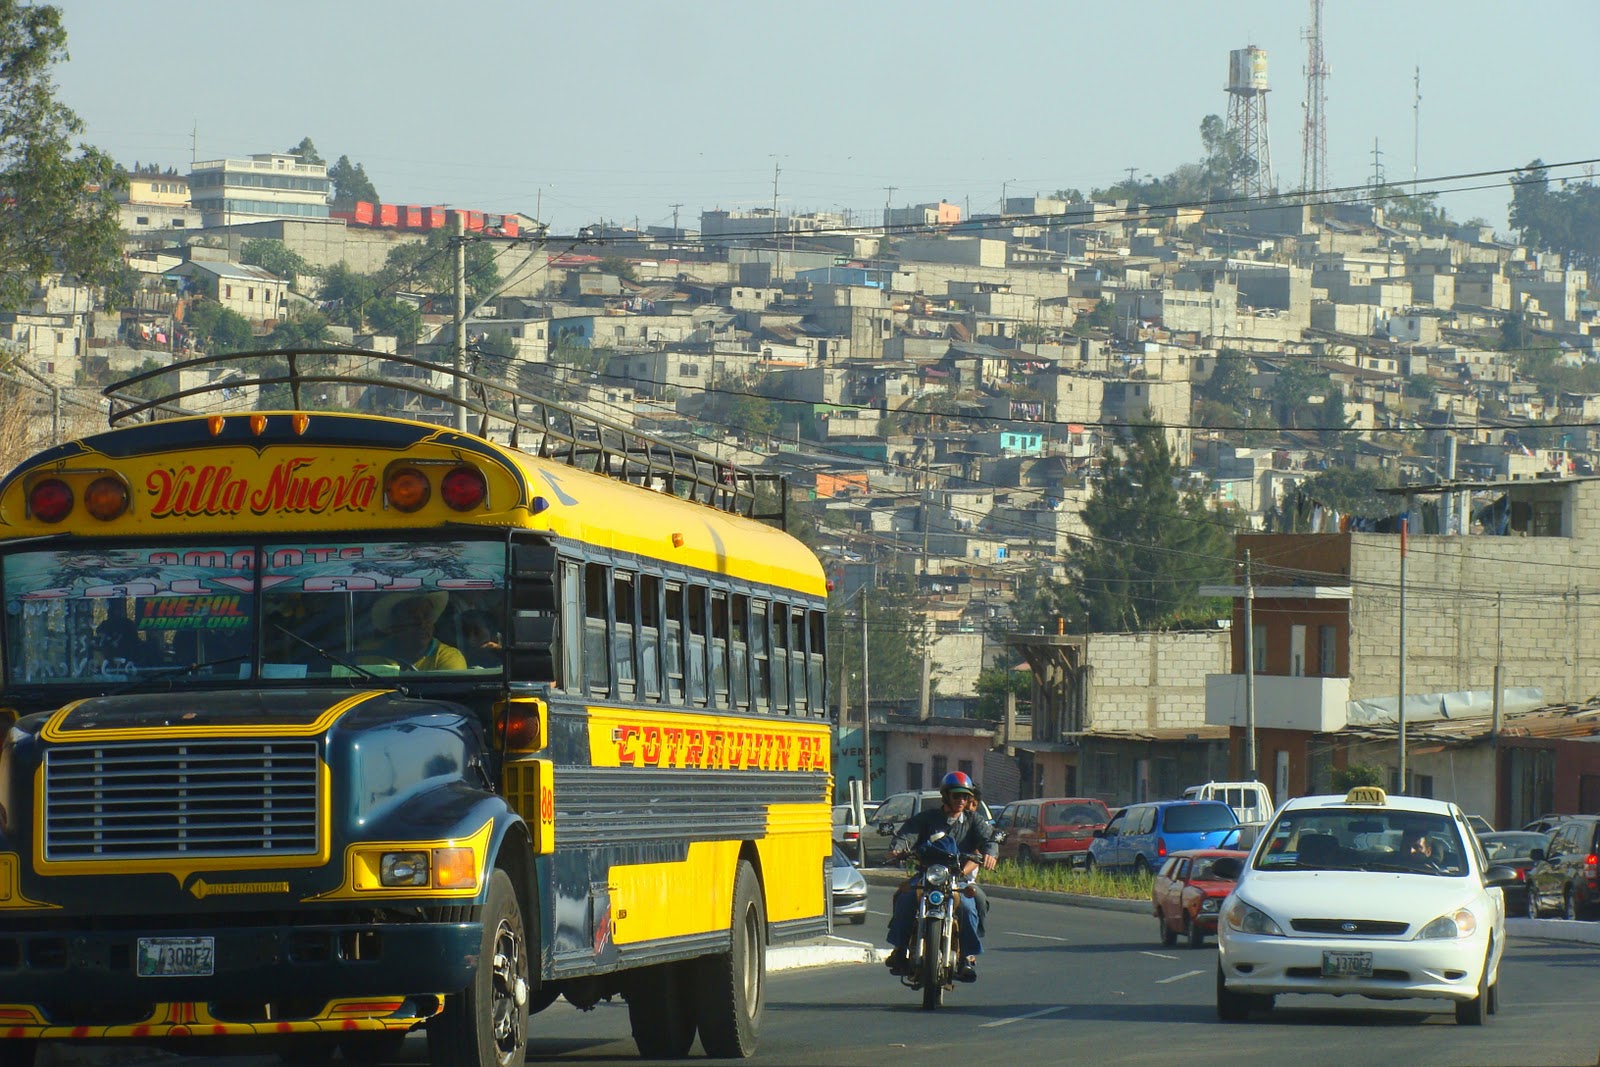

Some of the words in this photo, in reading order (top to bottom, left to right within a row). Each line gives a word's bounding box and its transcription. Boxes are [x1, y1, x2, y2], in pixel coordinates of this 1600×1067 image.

[146, 465, 248, 518] Villa
[250, 457, 377, 516] Nueva
[143, 595, 245, 618] TREBOL
[542, 785, 553, 820] 88
[1353, 790, 1381, 801] TAXI
[211, 882, 290, 895] INTERNATIONAL
